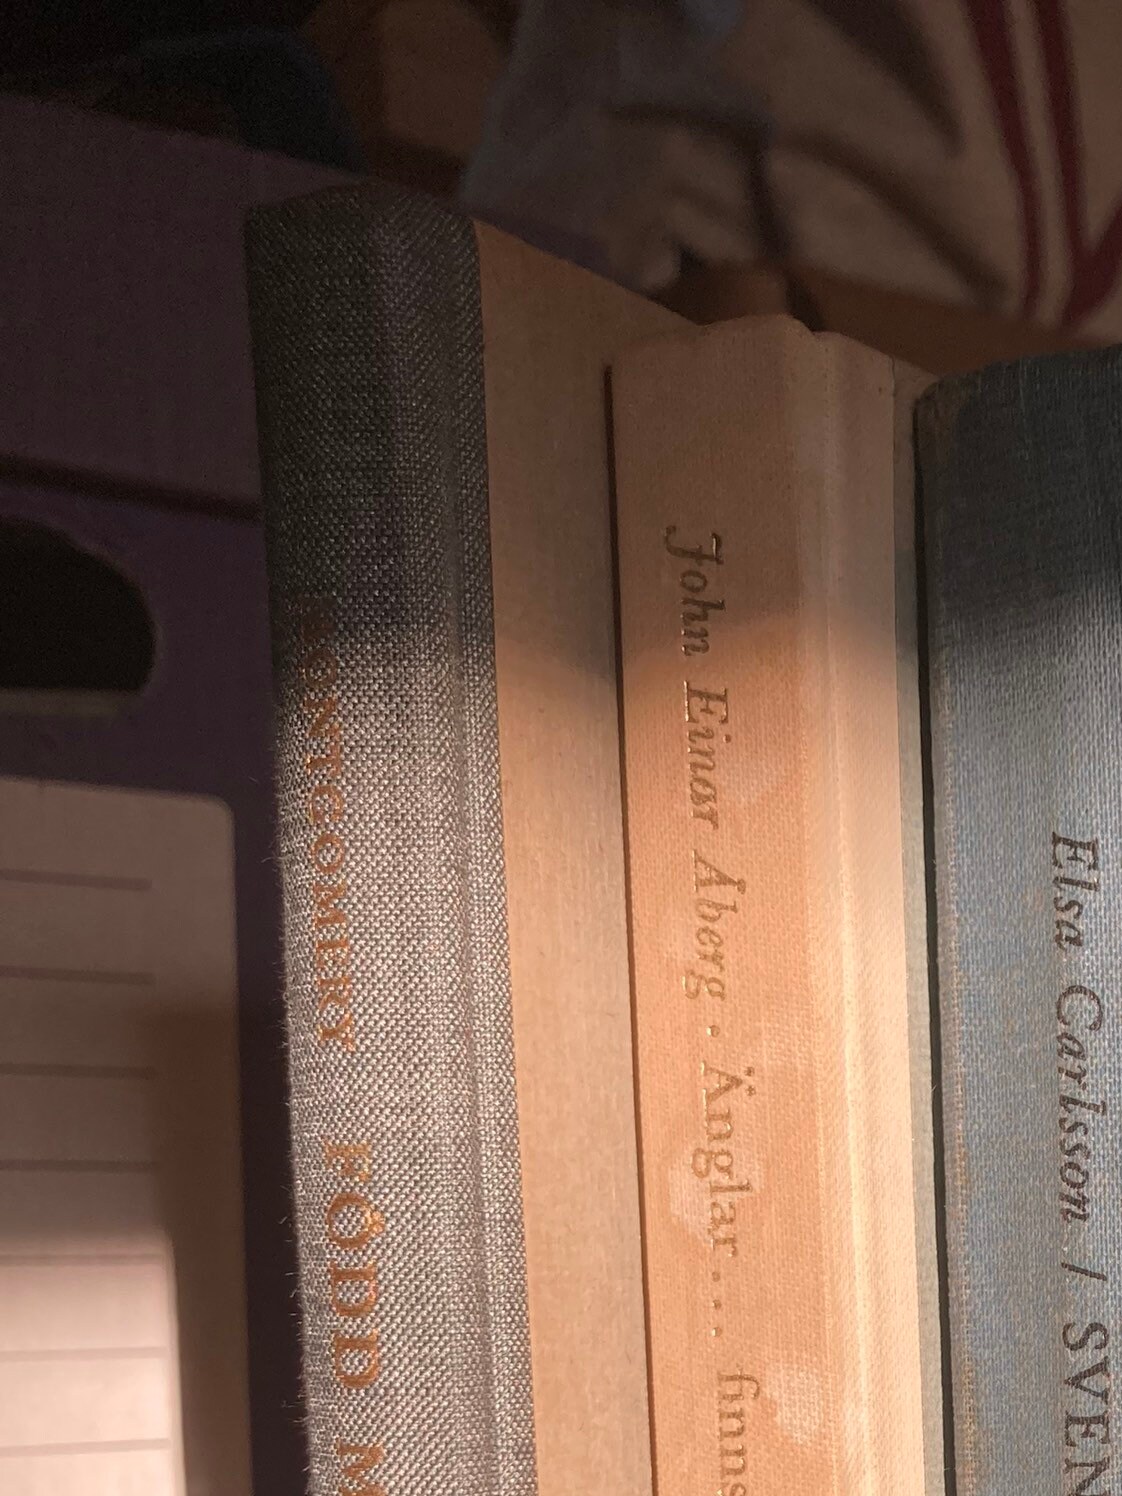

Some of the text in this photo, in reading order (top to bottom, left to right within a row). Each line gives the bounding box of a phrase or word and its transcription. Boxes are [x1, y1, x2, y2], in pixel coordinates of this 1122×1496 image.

[662, 525, 726, 657] John
[298, 597, 357, 1054] MONTGOMERY
[684, 680, 730, 830] Einar
[1051, 831, 1099, 950] Elsa
[1056, 984, 1107, 1223] Carlsson
[321, 1139, 385, 1389] FÖDD
